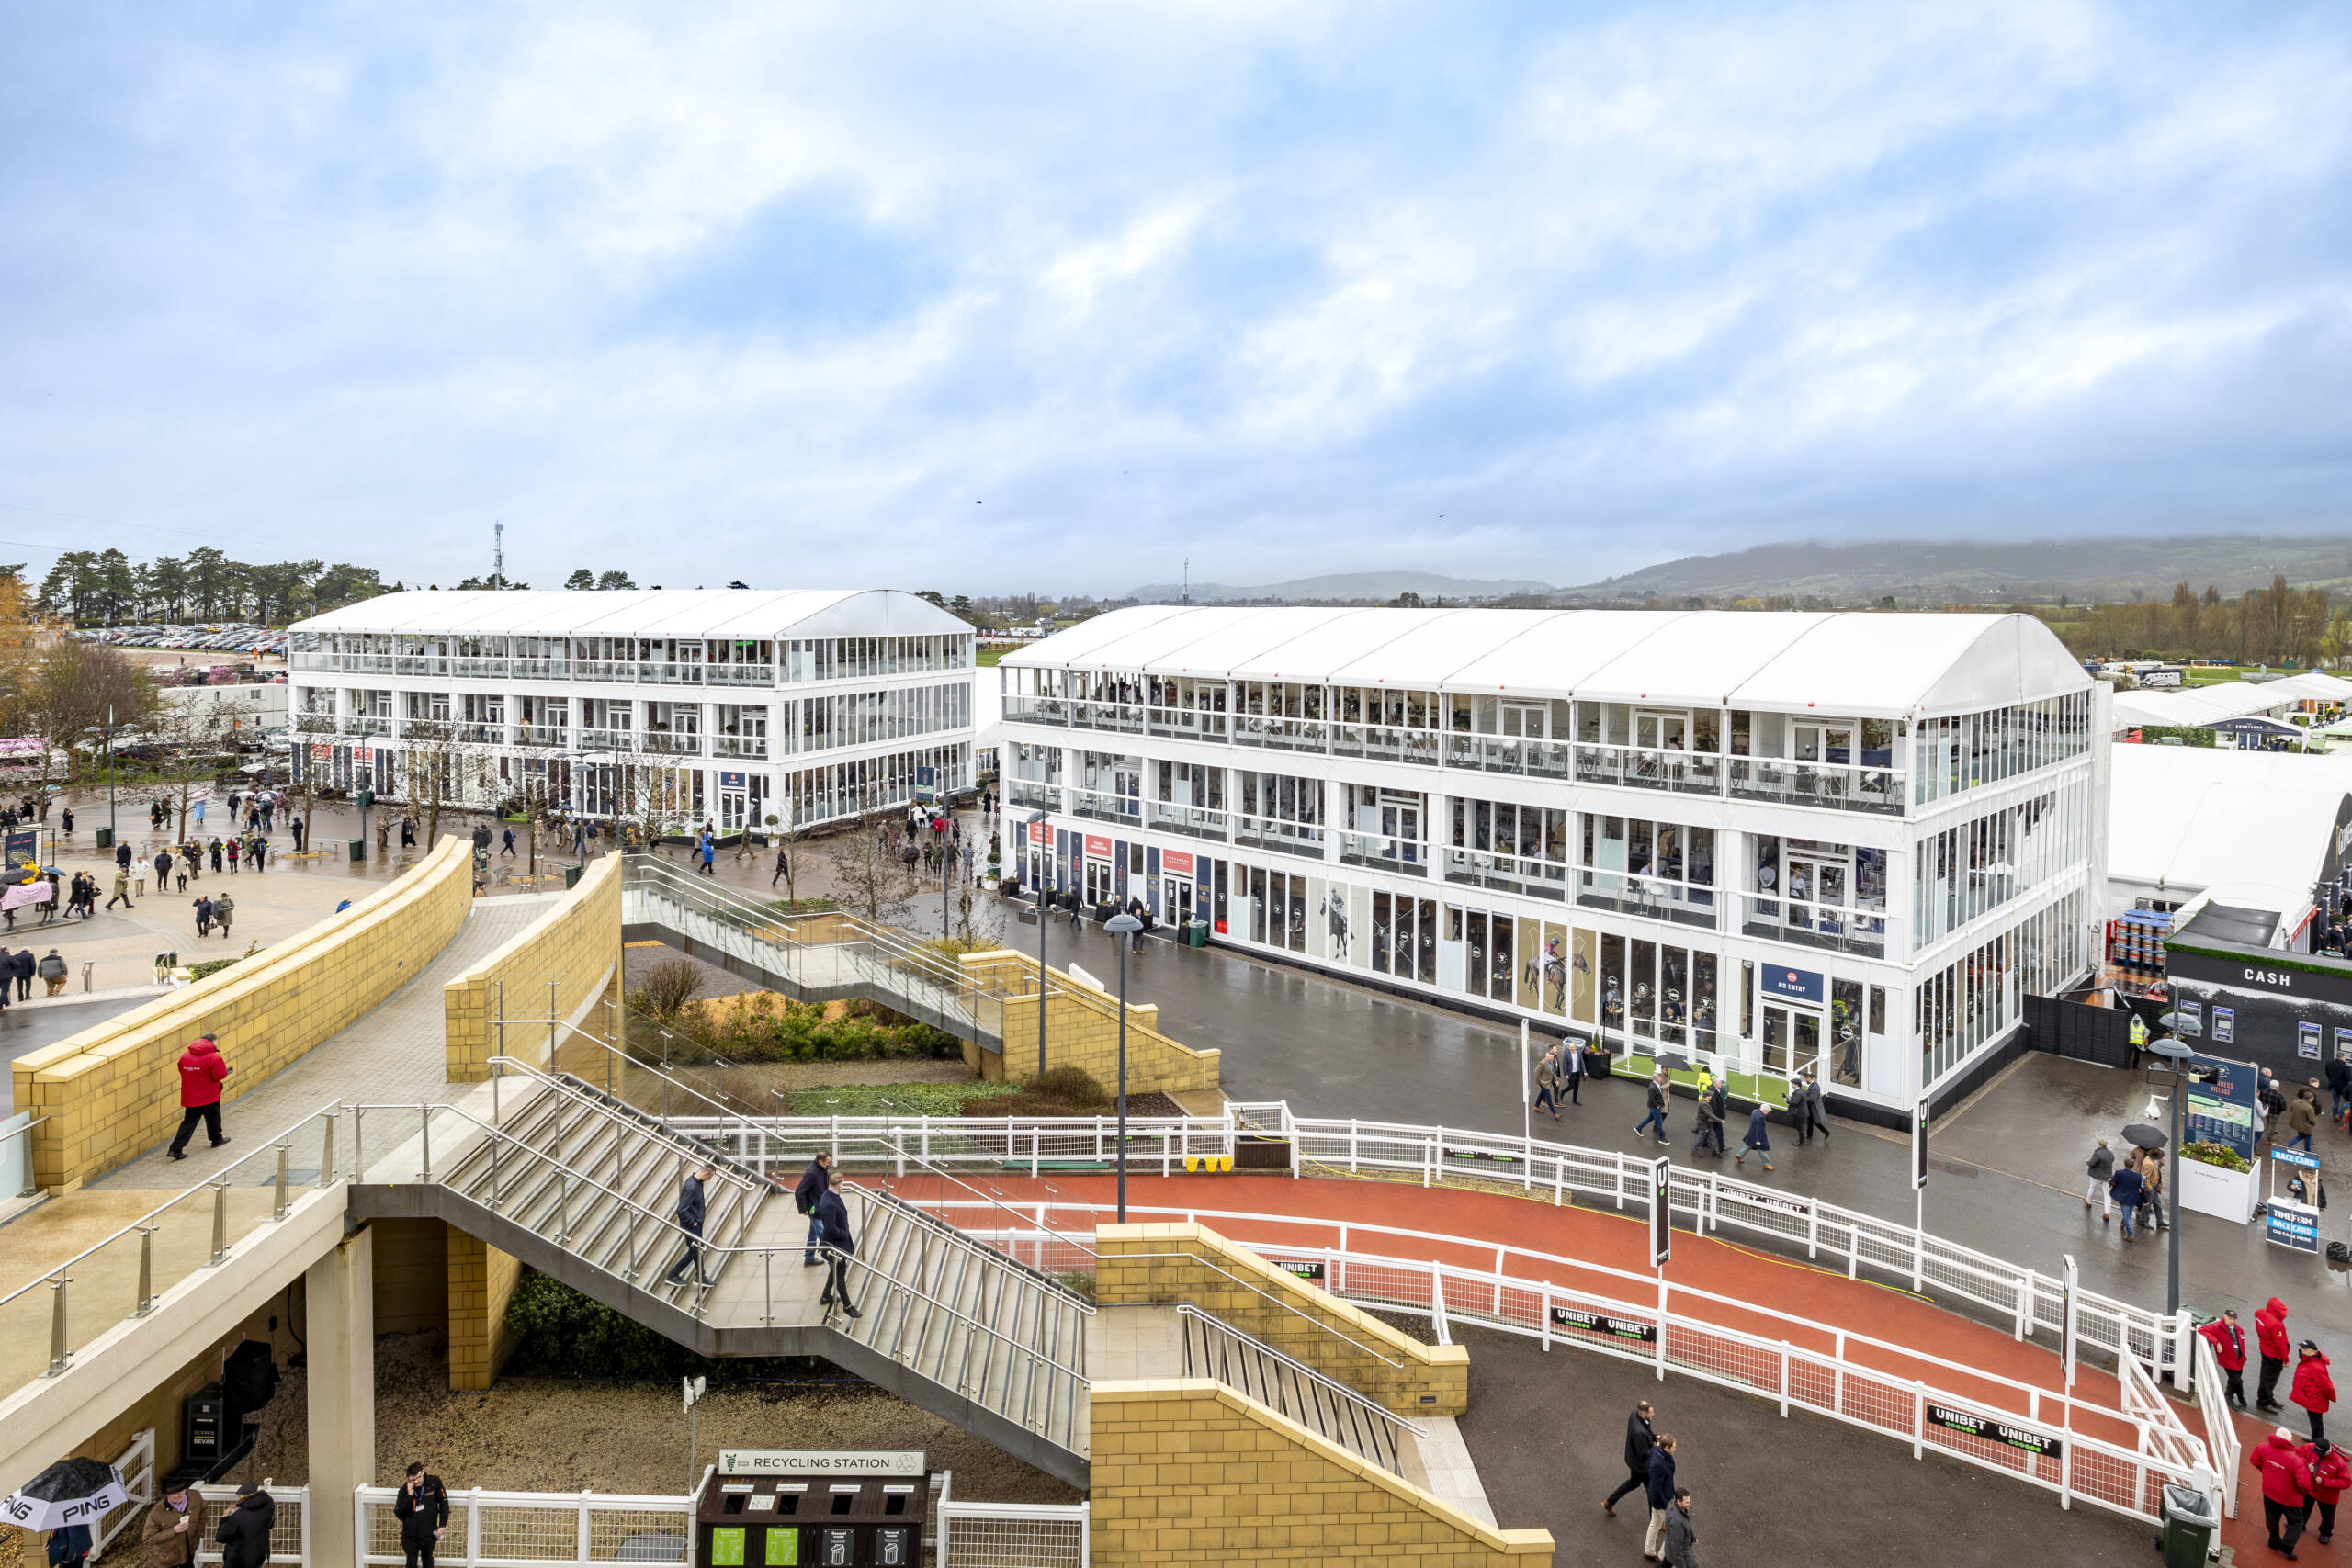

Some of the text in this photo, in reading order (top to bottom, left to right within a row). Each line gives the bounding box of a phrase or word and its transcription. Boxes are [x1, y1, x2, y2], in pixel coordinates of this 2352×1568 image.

[2244, 968, 2290, 987] CASH
[1778, 981, 1806, 993] NO ENTRY
[2275, 1151, 2316, 1167] RACE CARD
[1657, 1166, 1668, 1188] U
[2272, 1219, 2312, 1235] RACE CARD
[2281, 1231, 2297, 1240] SALE
[2297, 1235, 2312, 1243] HERE
[1280, 1262, 1317, 1273] UNIBET
[1557, 1309, 1649, 1336] UNIBET UNIBET
[1936, 1407, 2052, 1450] UNIBET UNIBET
[753, 1458, 831, 1469] RECYCLING
[833, 1458, 890, 1469] STATION
[62, 1495, 110, 1523] PING
